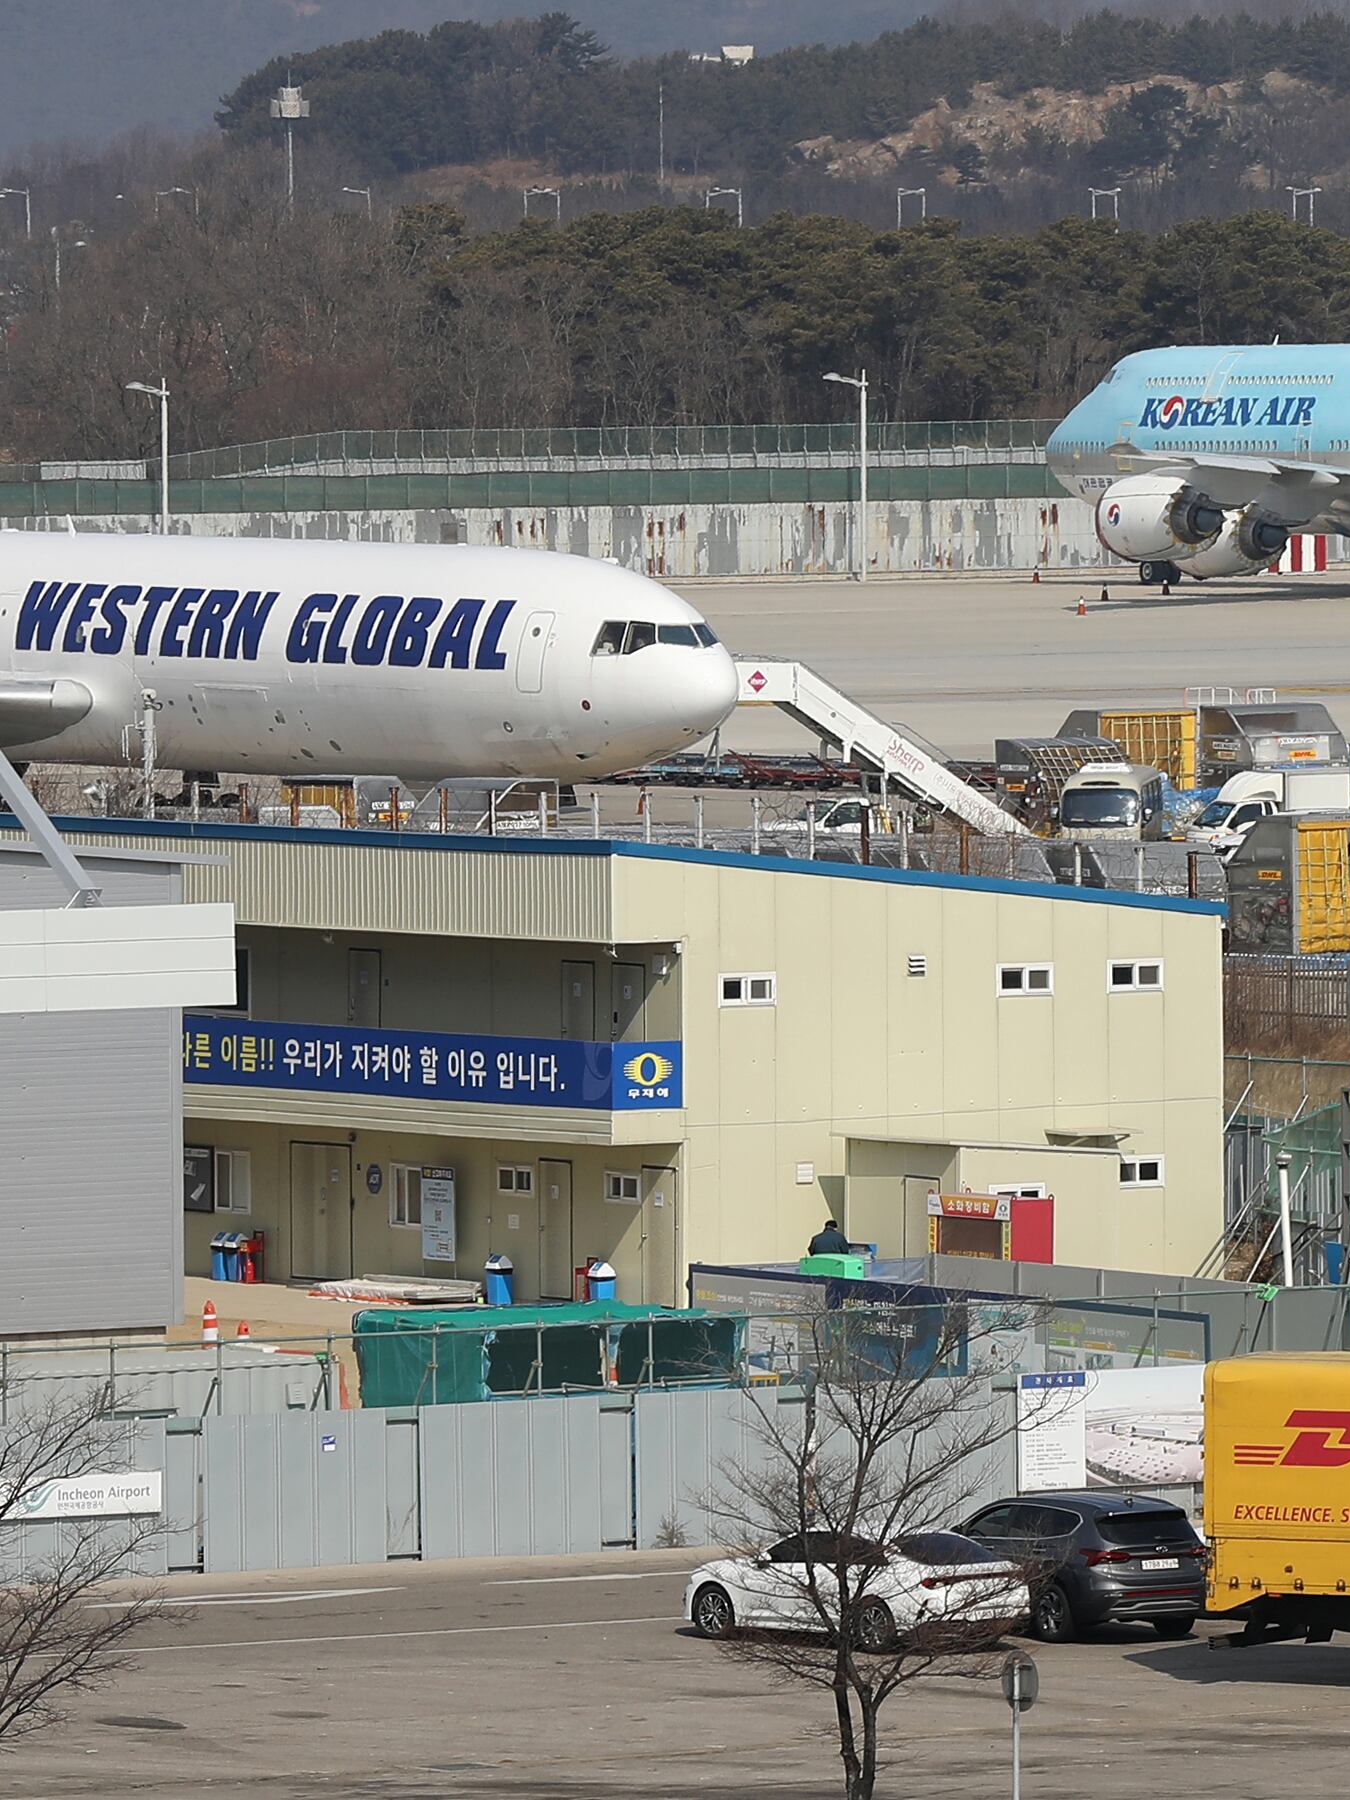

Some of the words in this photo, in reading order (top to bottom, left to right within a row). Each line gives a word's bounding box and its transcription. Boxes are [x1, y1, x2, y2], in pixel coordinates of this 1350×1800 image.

[1139, 396, 1260, 430] KOREAN
[1255, 396, 1317, 427] AIR
[15, 580, 280, 661] WESTERN
[285, 593, 518, 670] GLOBAL
[888, 738, 926, 775] Sharp
[220, 1034, 274, 1073] 이름!!
[282, 1038, 343, 1079] 우리가
[351, 1042, 411, 1083] 지켜야
[419, 1046, 438, 1085] 할
[447, 1049, 487, 1088] 이유
[497, 1052, 566, 1093] 입니다.
[57, 1488, 104, 1501] Incheon
[107, 1485, 150, 1501] Airport
[1234, 1504, 1335, 1523] EXCELLENCE.
